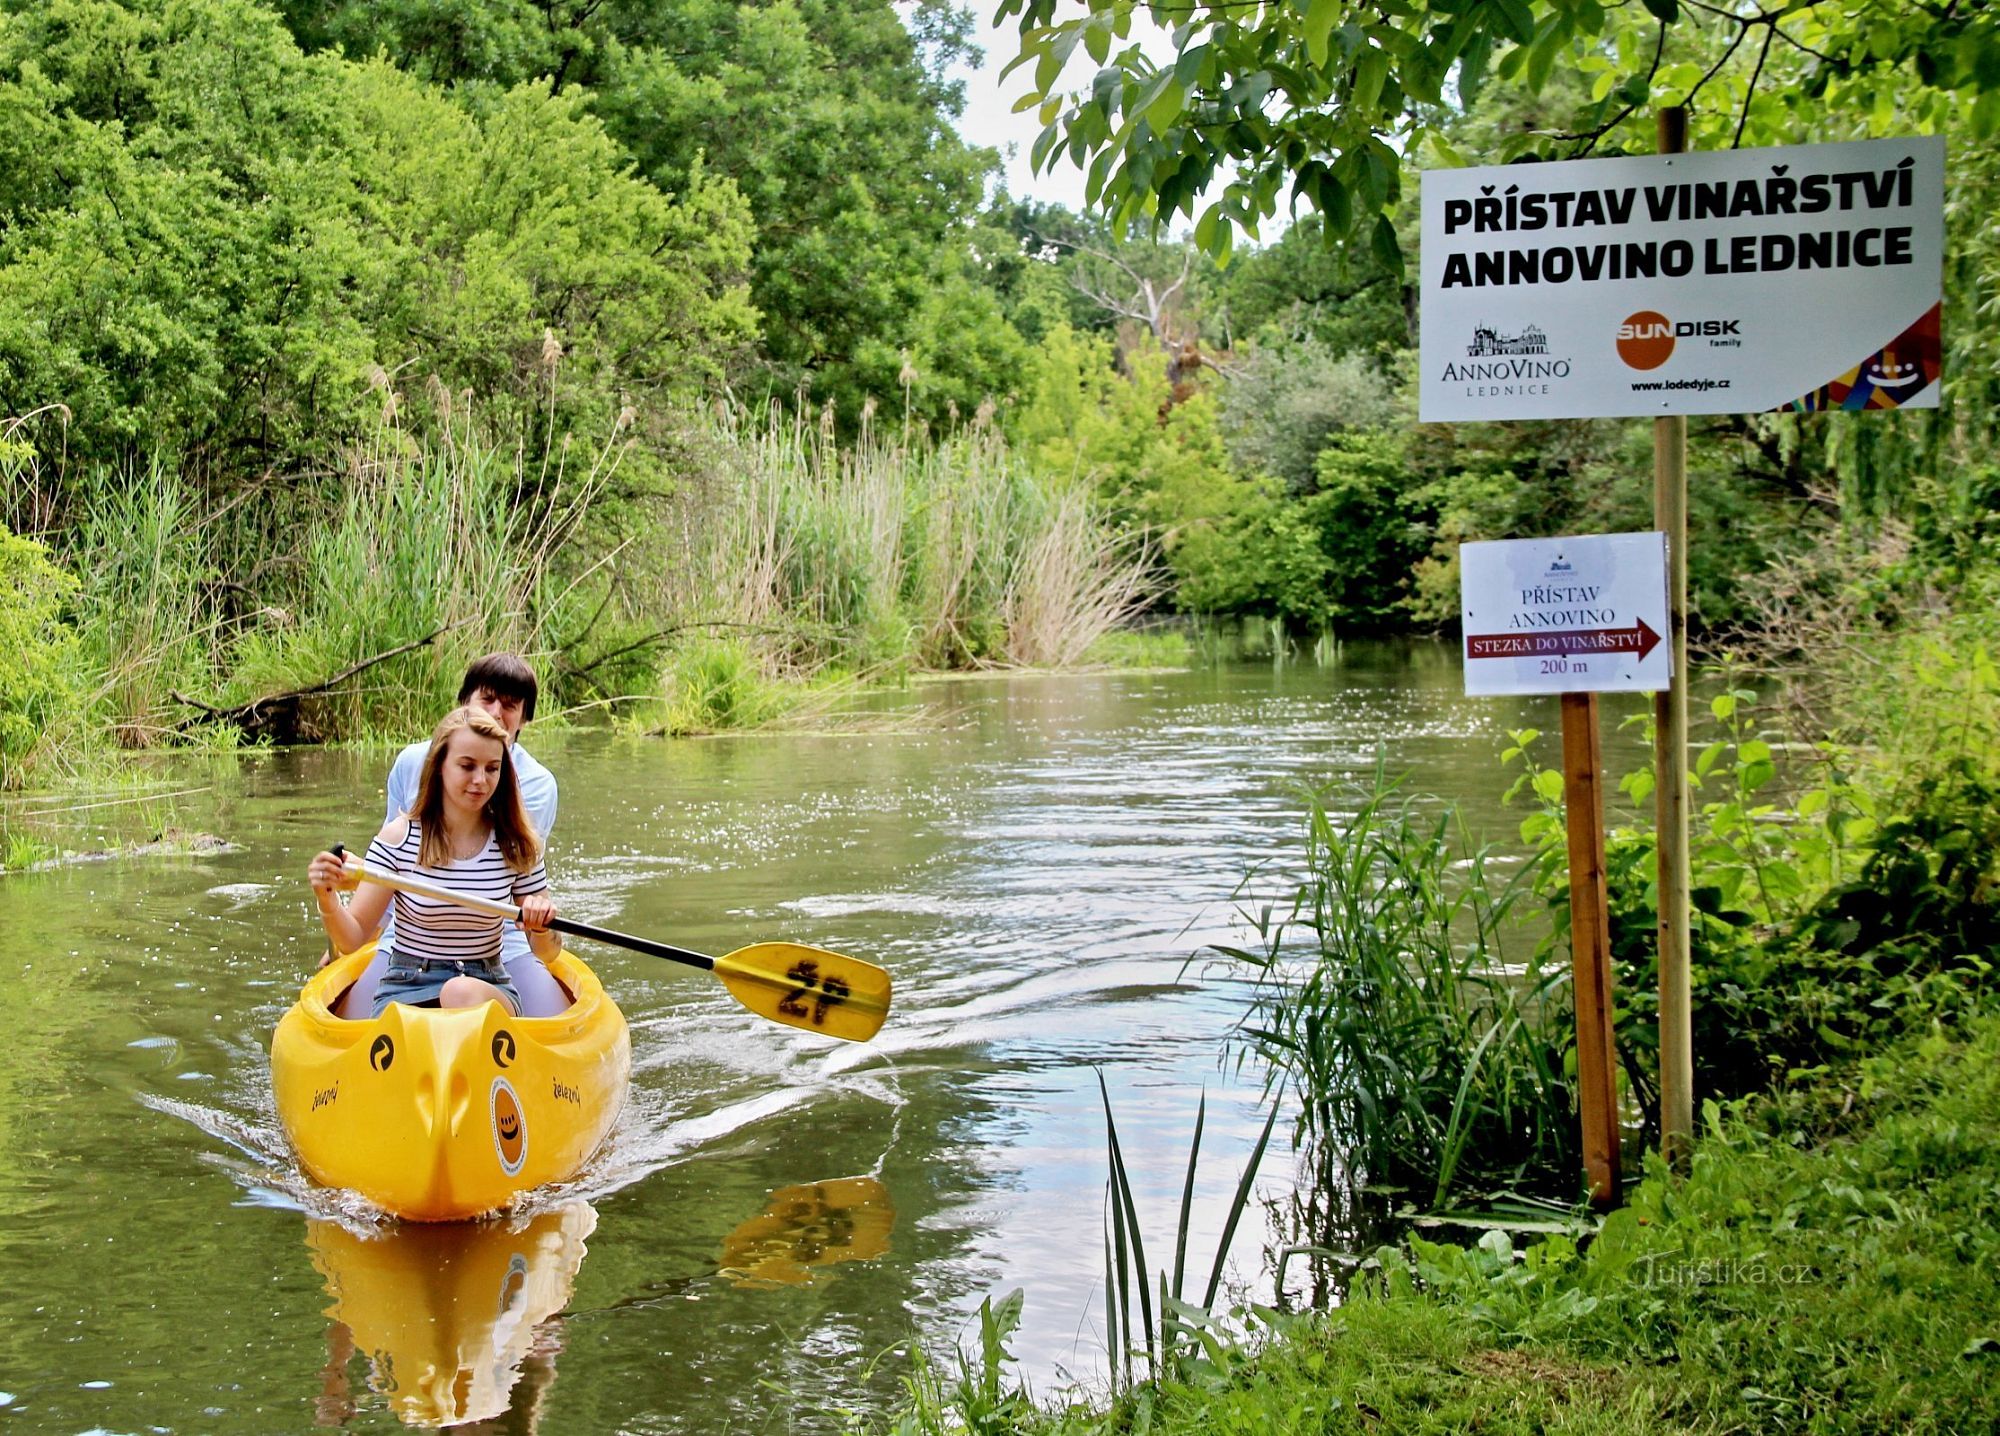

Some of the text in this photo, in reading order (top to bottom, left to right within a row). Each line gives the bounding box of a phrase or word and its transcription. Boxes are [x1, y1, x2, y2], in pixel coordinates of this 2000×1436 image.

[1444, 156, 1915, 235] PŘÍSTAV VINAŘSTVÍ
[1441, 226, 1913, 288] ANNOVINO LEDNICE
[1616, 320, 1741, 341] SUNDISK
[1709, 338, 1742, 348] family
[1466, 384, 1549, 397] LEDNICE
[1631, 378, 1731, 392] www.lodedyje.cz
[1522, 584, 1600, 605] PŘÍSTAV
[1509, 608, 1616, 629] ANNOVINO
[1473, 630, 1643, 654] STEZKA DO VINAŘSTVÍ
[1540, 659, 1588, 674] 200 m
